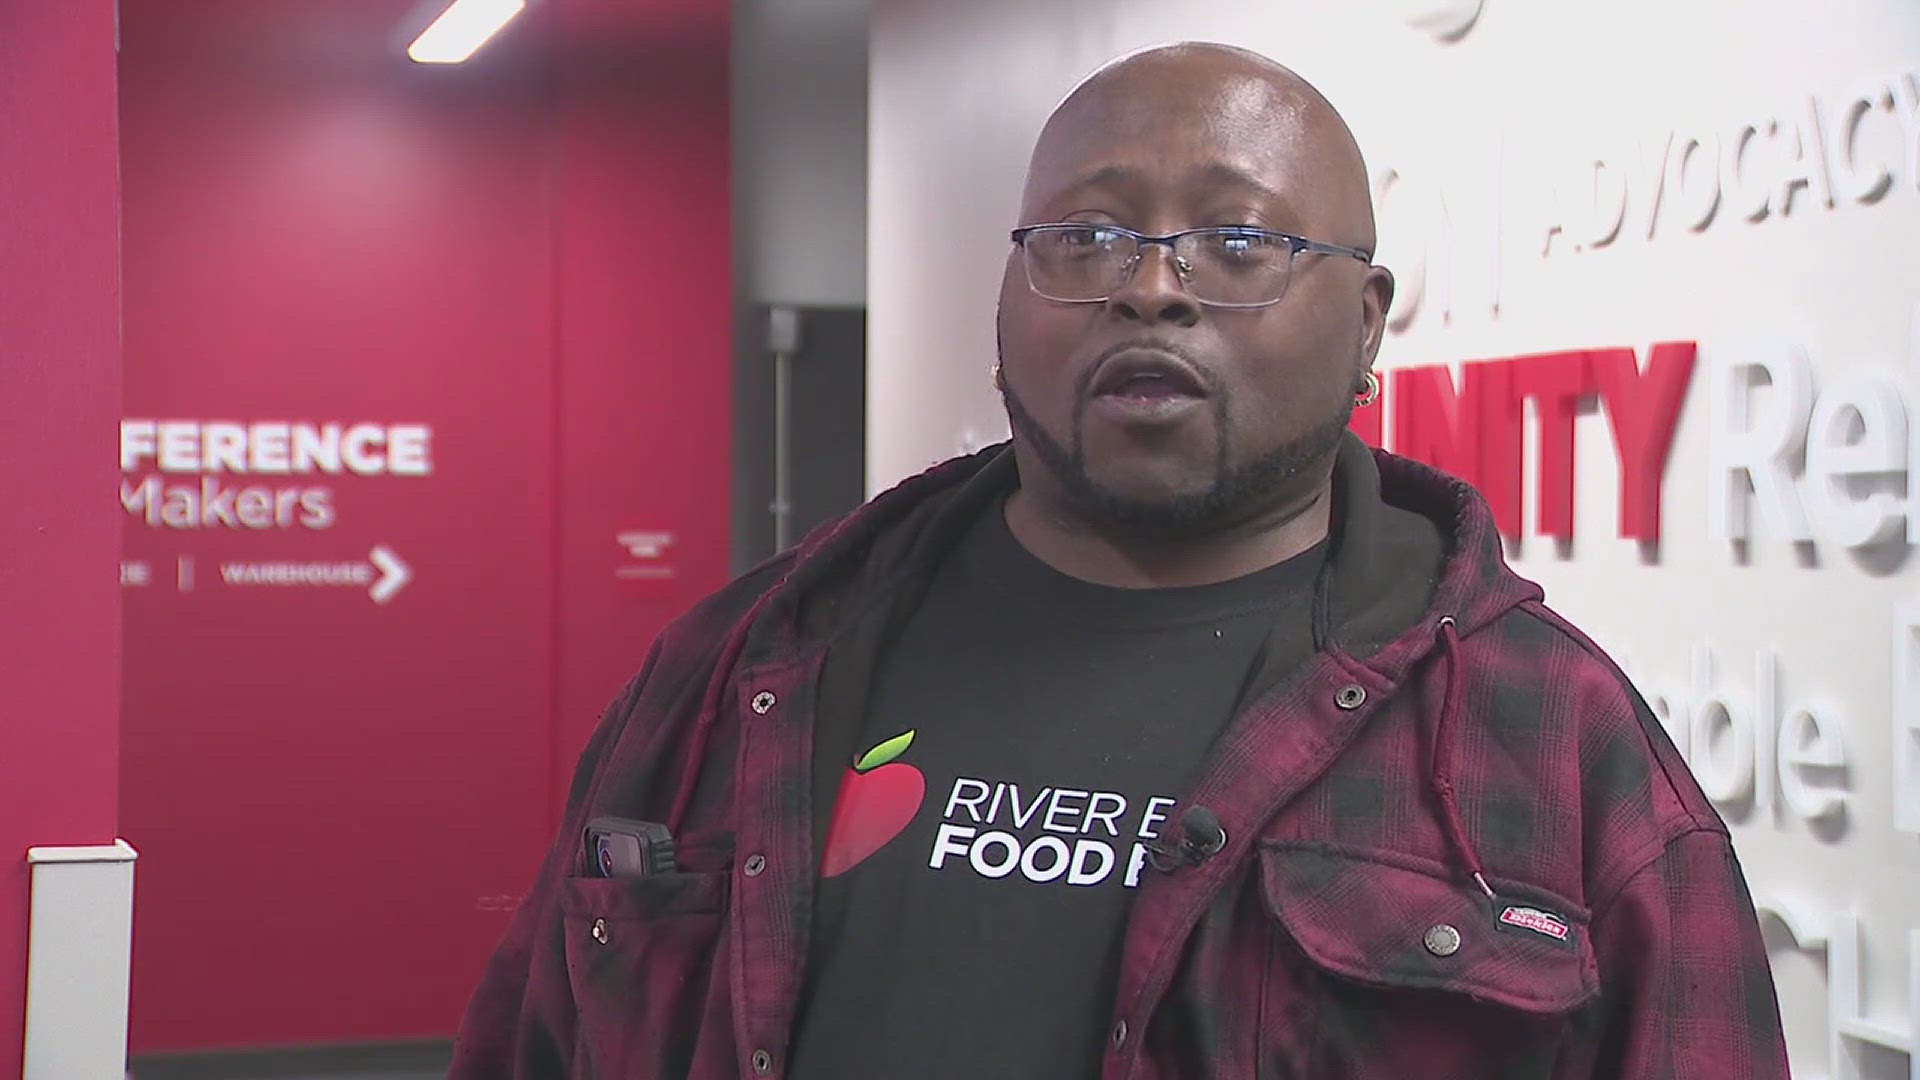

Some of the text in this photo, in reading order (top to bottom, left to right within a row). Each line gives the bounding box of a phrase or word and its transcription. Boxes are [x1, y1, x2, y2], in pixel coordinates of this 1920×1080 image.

[1539, 72, 1919, 258] ADVOCAC
[120, 420, 432, 475] FERENCE
[1709, 300, 1919, 556] Re
[120, 475, 335, 530] Makers
[220, 561, 371, 586] WAREHOUSE
[944, 777, 1127, 837] RIVER
[929, 823, 1115, 887] FOOD
